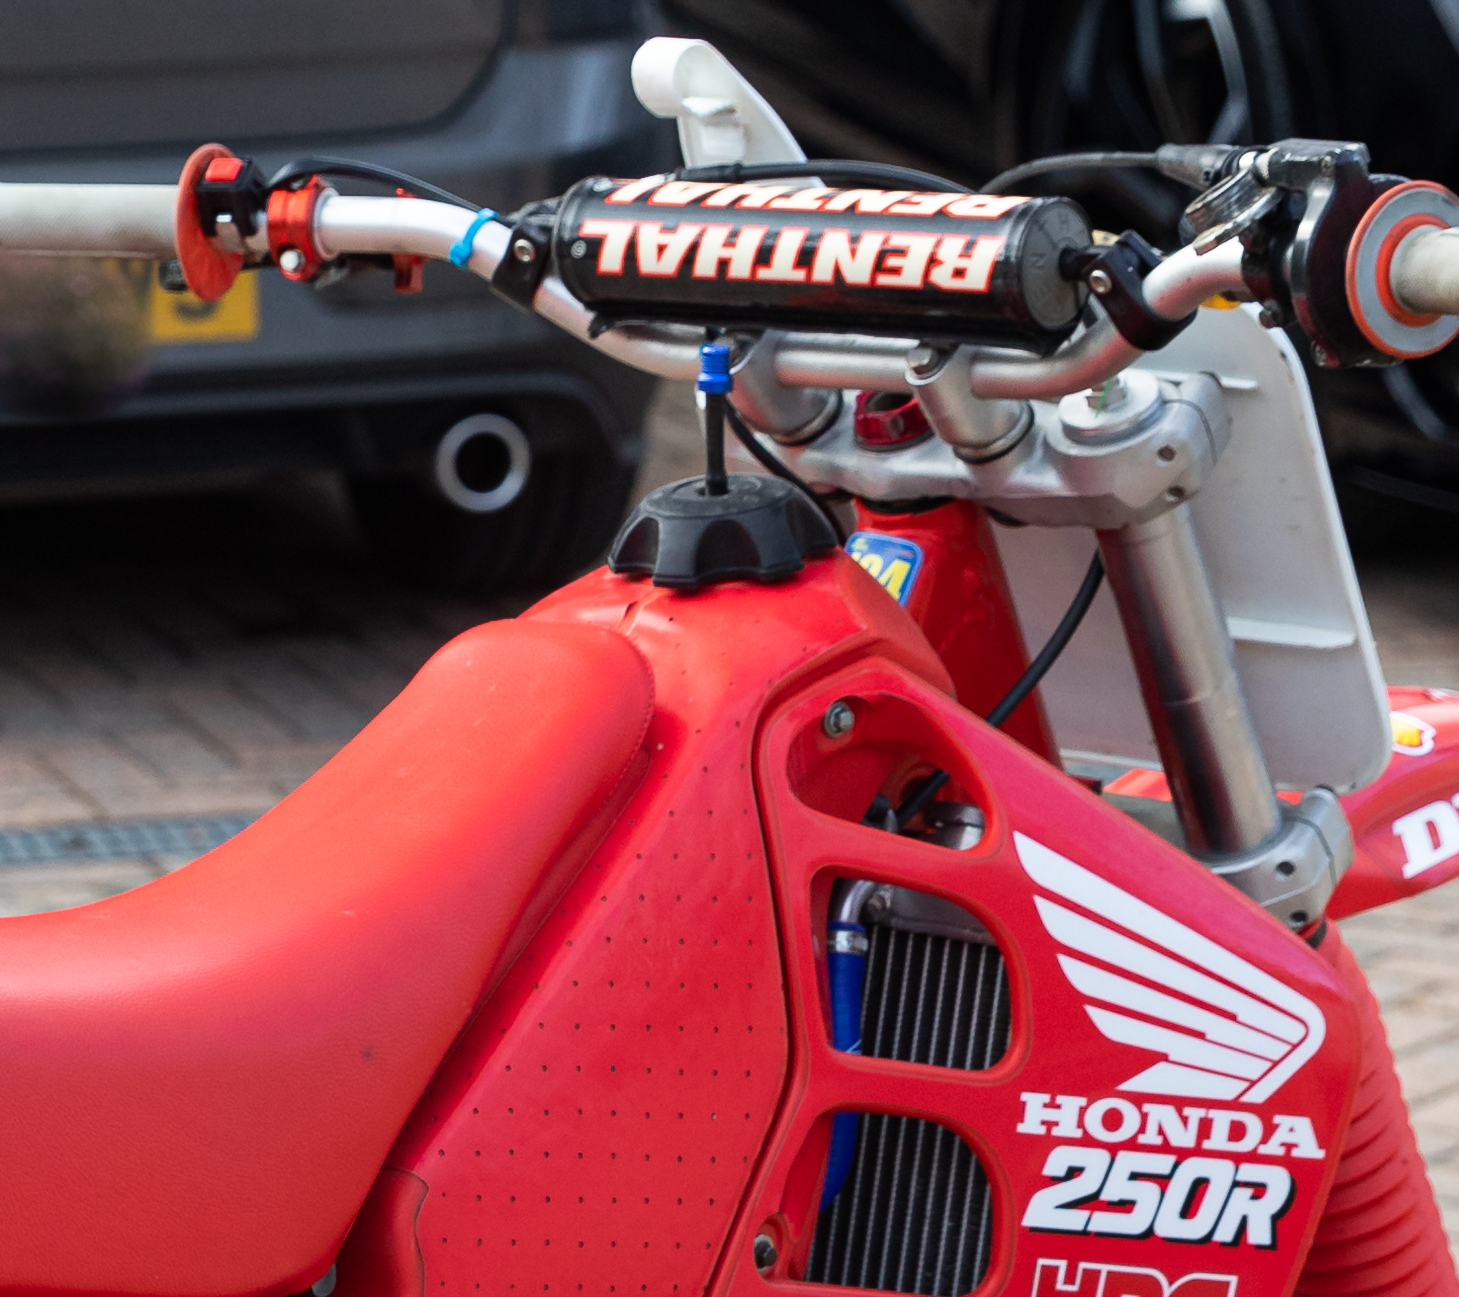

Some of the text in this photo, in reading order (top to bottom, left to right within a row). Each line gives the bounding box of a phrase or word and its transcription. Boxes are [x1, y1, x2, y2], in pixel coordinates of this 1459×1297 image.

[579, 217, 1006, 293] RENTHAL
[1016, 1091, 1326, 1160] HONDA
[1021, 1145, 1298, 1251] 250R
